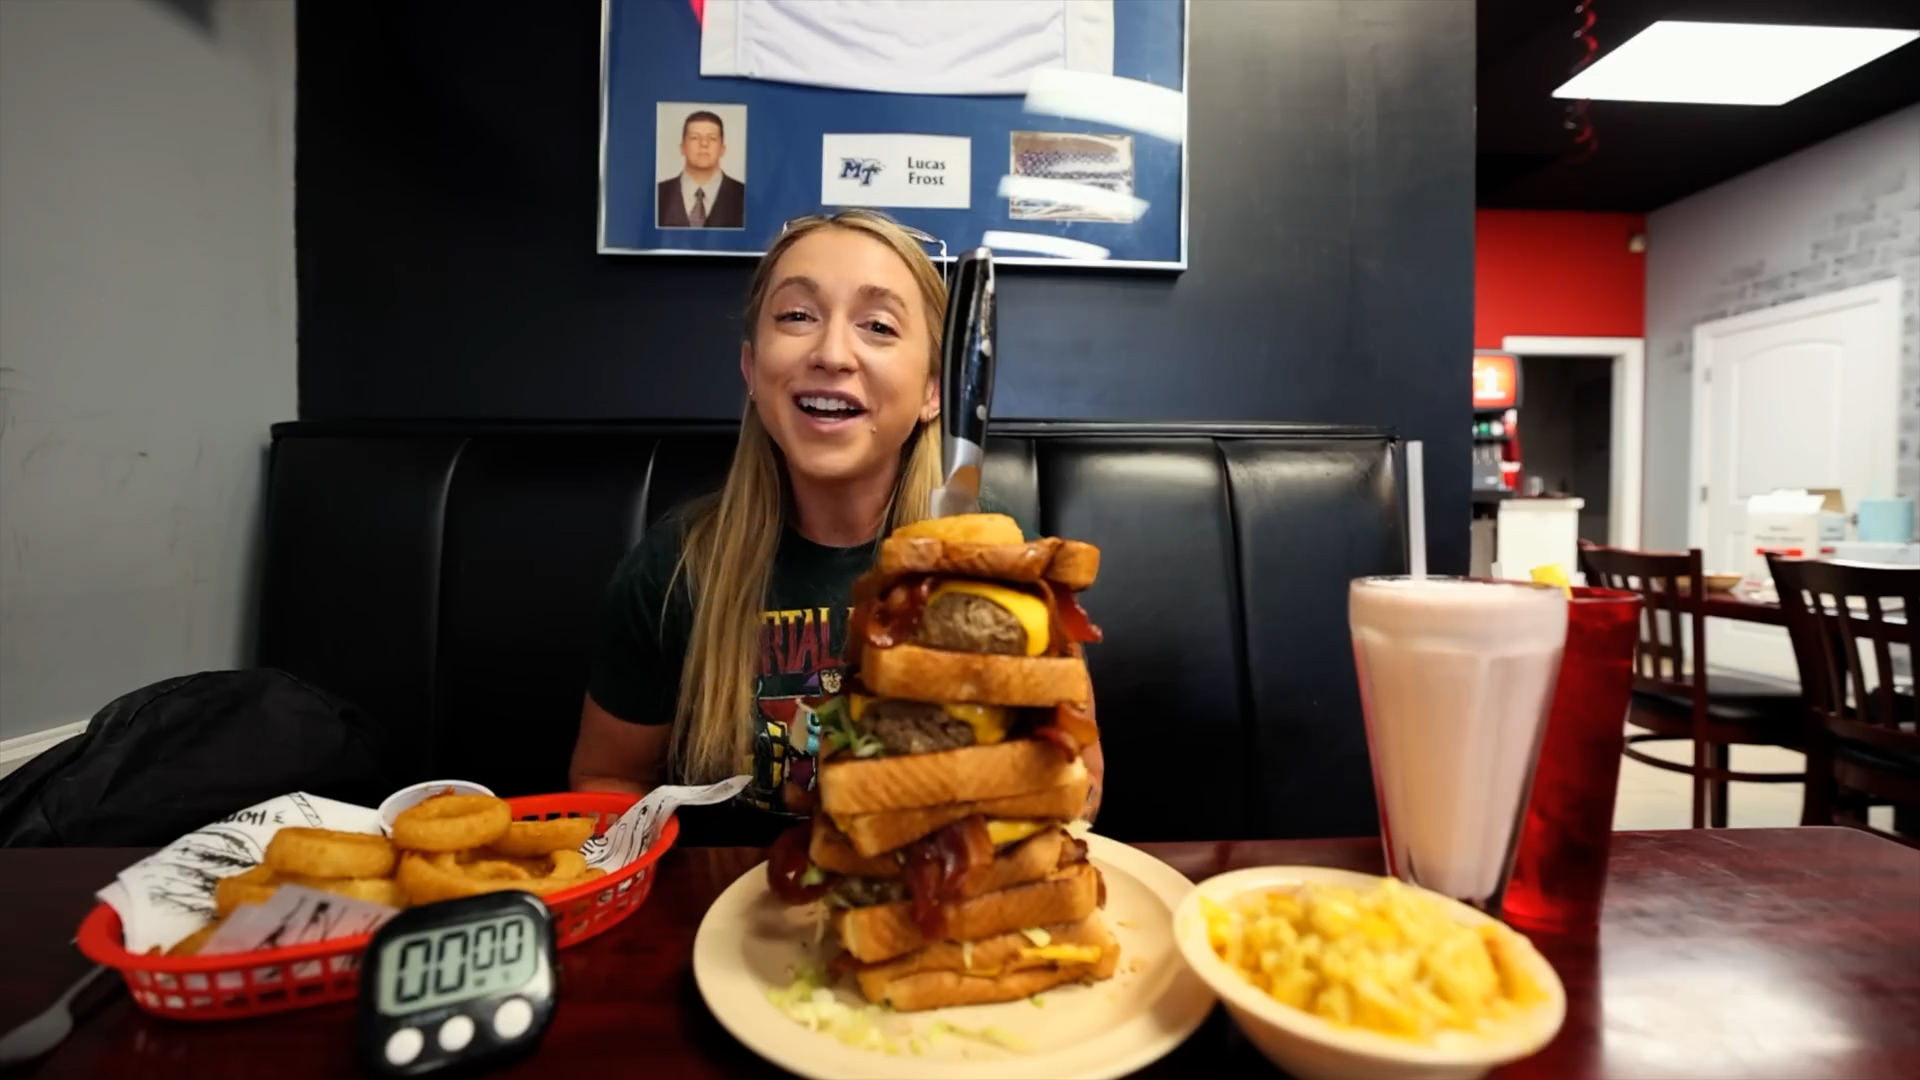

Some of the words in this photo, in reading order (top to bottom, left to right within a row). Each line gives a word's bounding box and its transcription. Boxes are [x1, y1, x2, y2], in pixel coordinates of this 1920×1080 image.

[839, 157, 882, 186] MT
[907, 156, 946, 170] Lucas
[908, 172, 945, 186] Frost
[757, 606, 847, 677] RTAL
